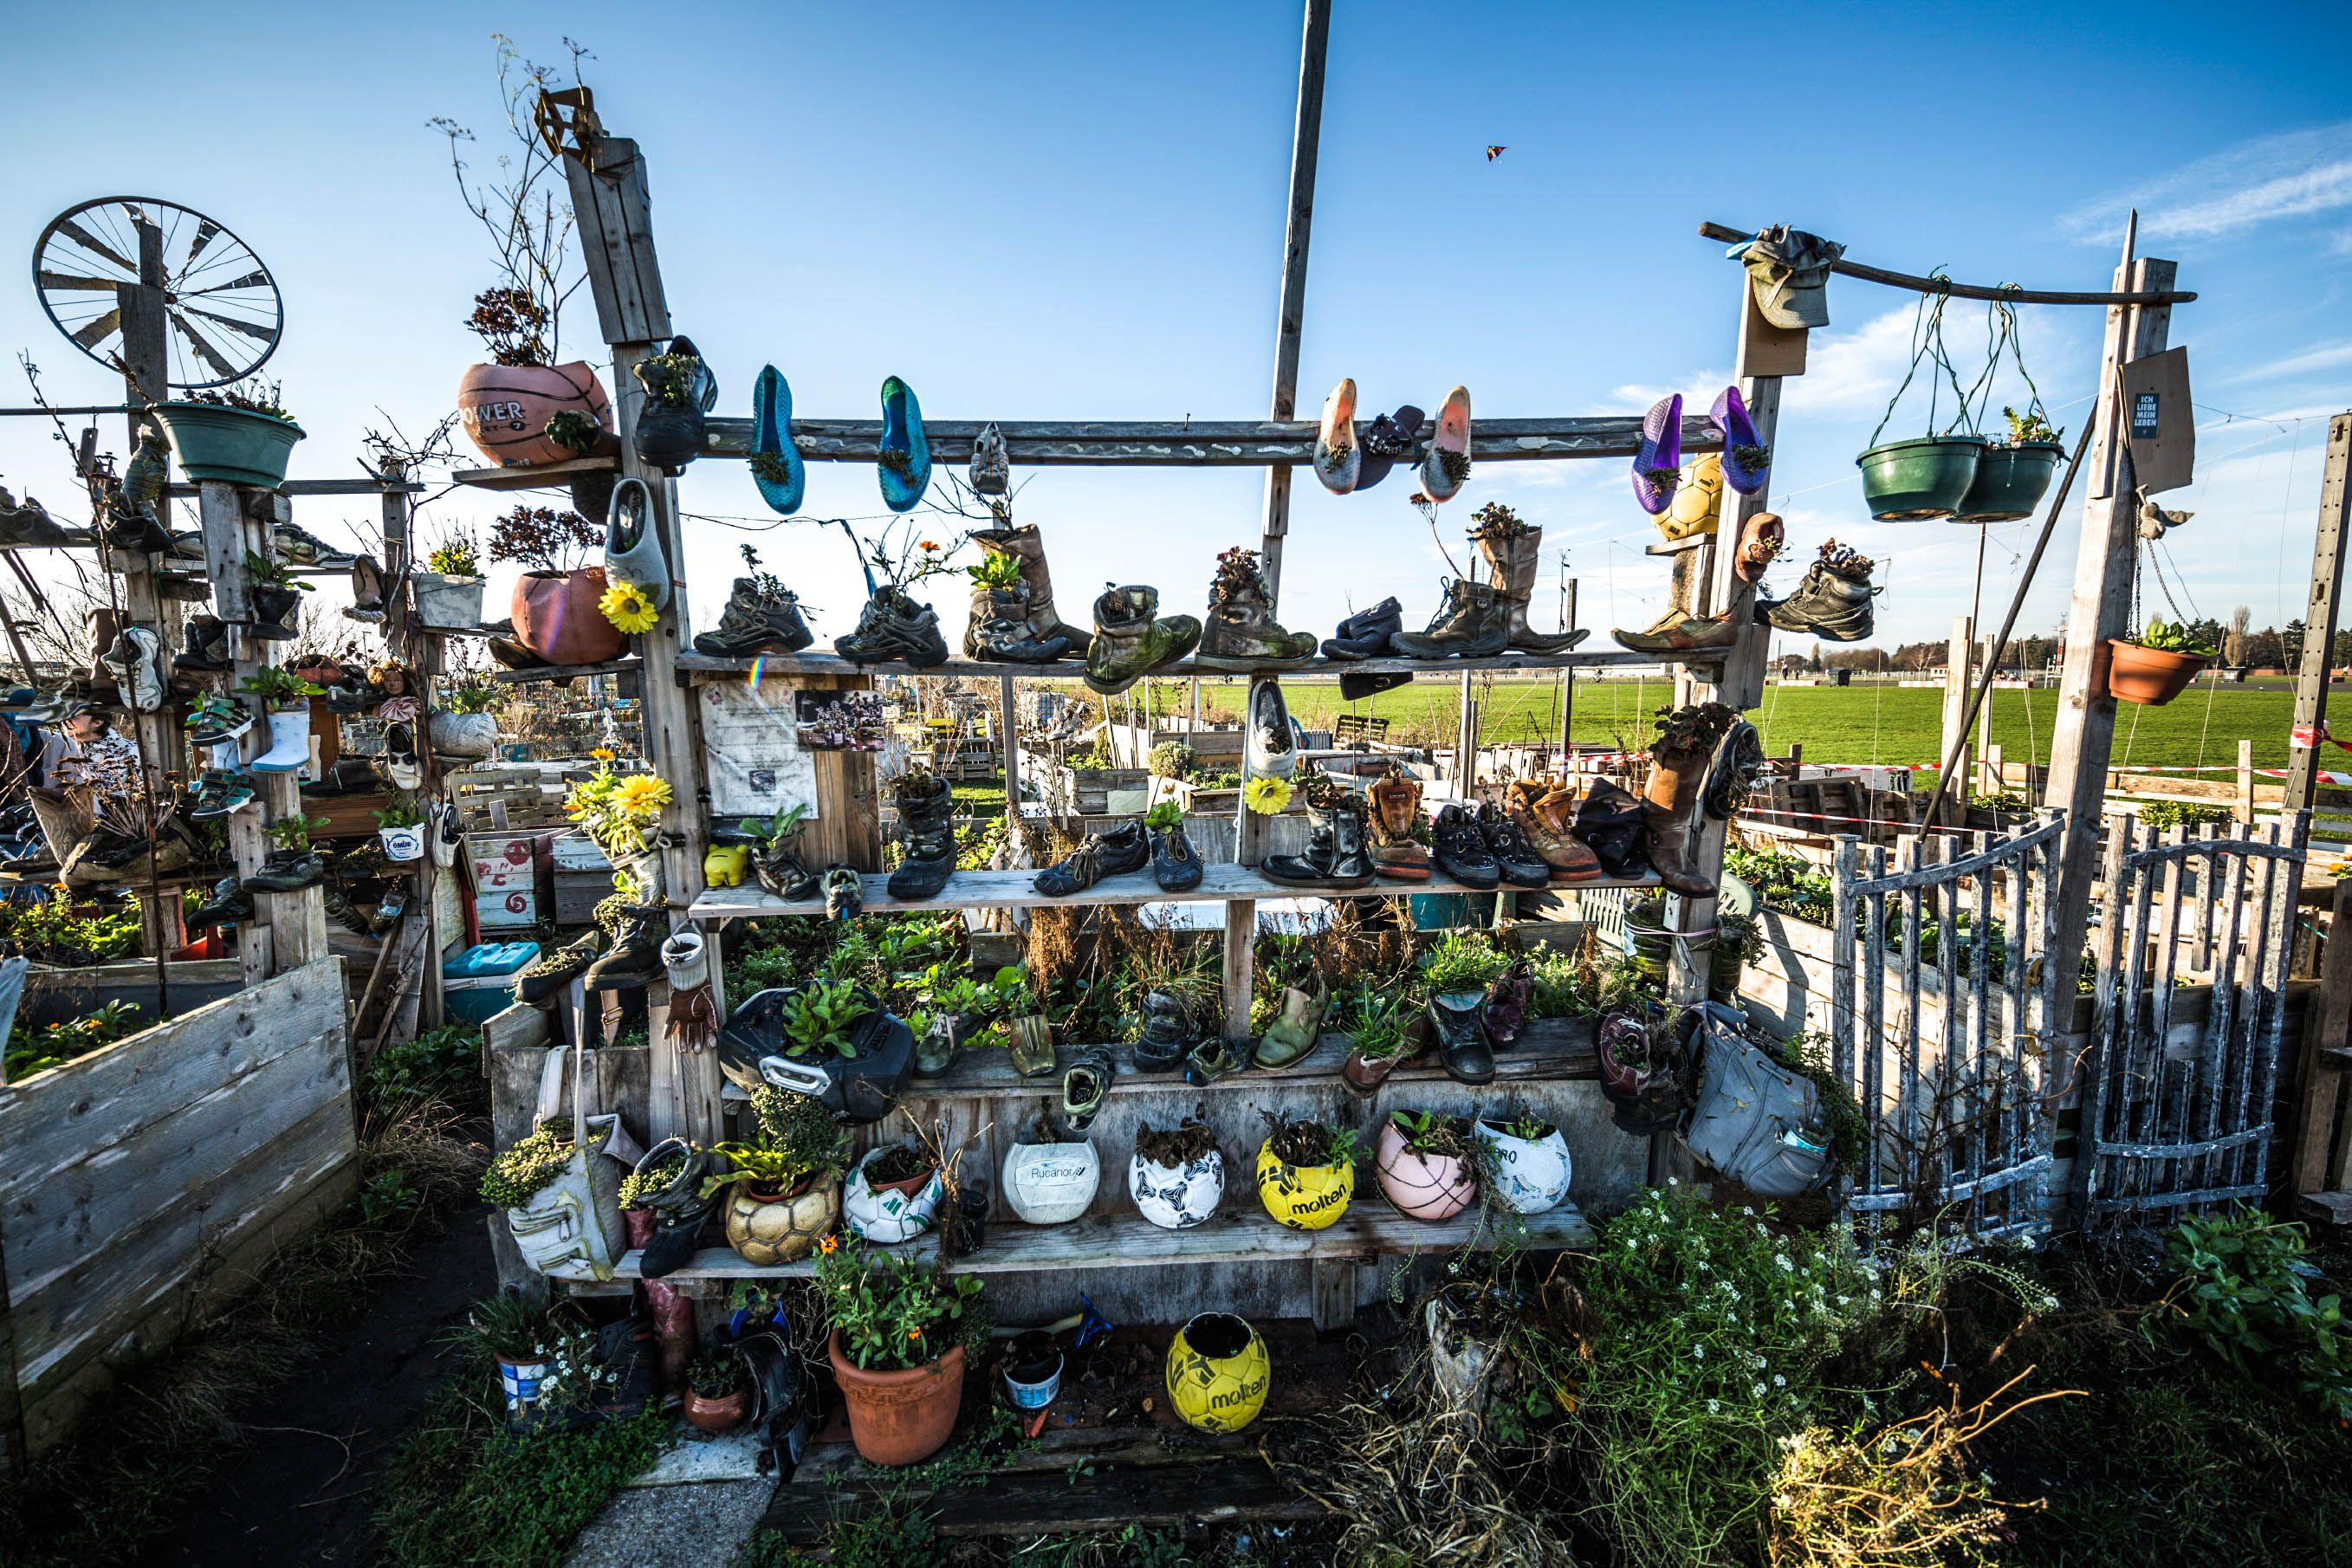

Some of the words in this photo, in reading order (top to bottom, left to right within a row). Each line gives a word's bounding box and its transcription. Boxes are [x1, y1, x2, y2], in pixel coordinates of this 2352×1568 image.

[1031, 1167, 1072, 1179] Rucanor
[1292, 1183, 1346, 1215] molten
[1211, 1375, 1266, 1409] molten
